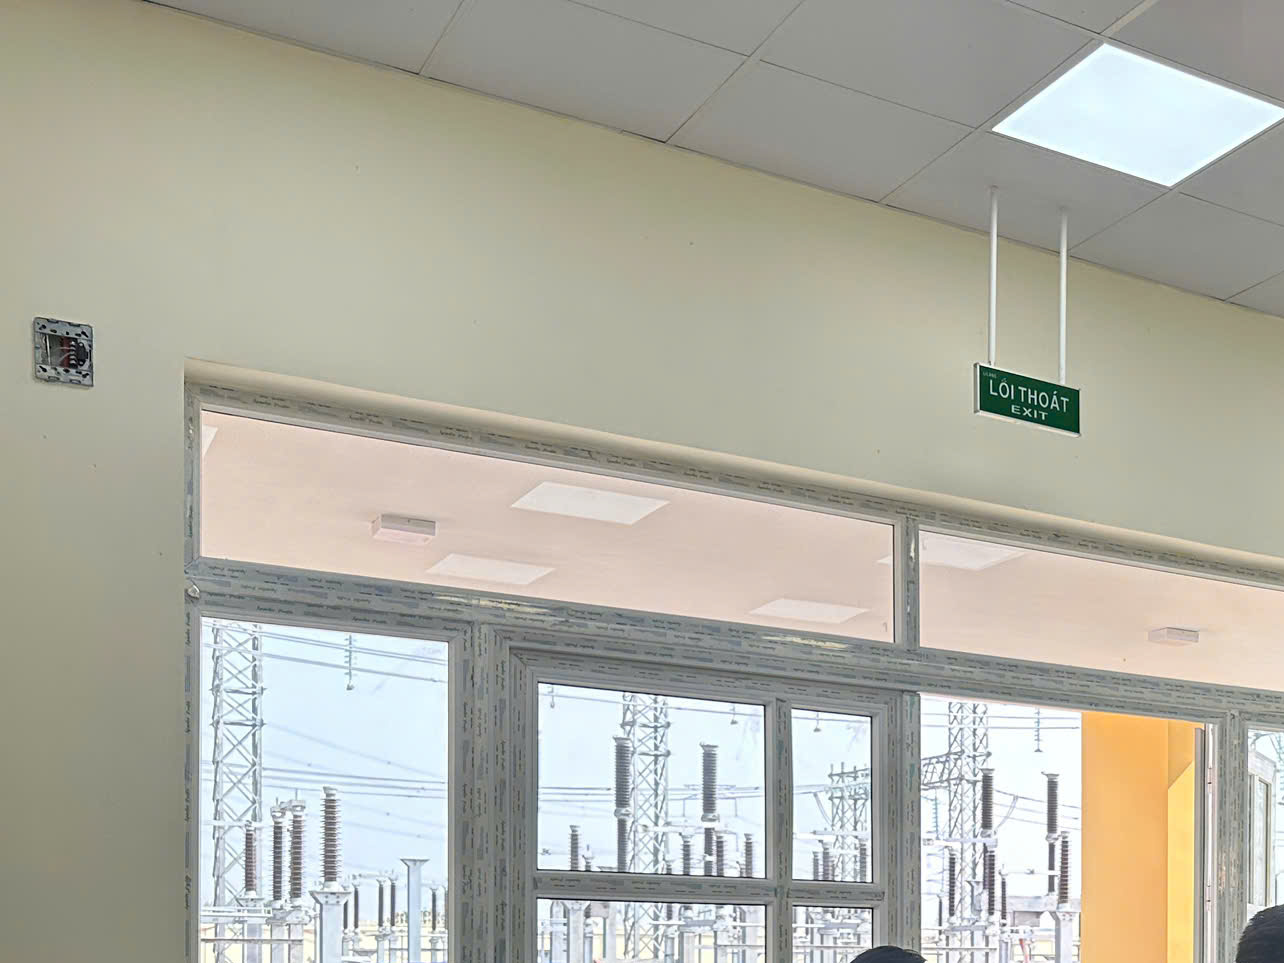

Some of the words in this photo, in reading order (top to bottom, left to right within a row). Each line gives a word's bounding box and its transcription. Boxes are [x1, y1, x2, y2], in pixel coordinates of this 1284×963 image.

[989, 378, 1015, 400] LỐI
[1018, 386, 1070, 413] THOÁT
[1011, 404, 1049, 421] EXIT
